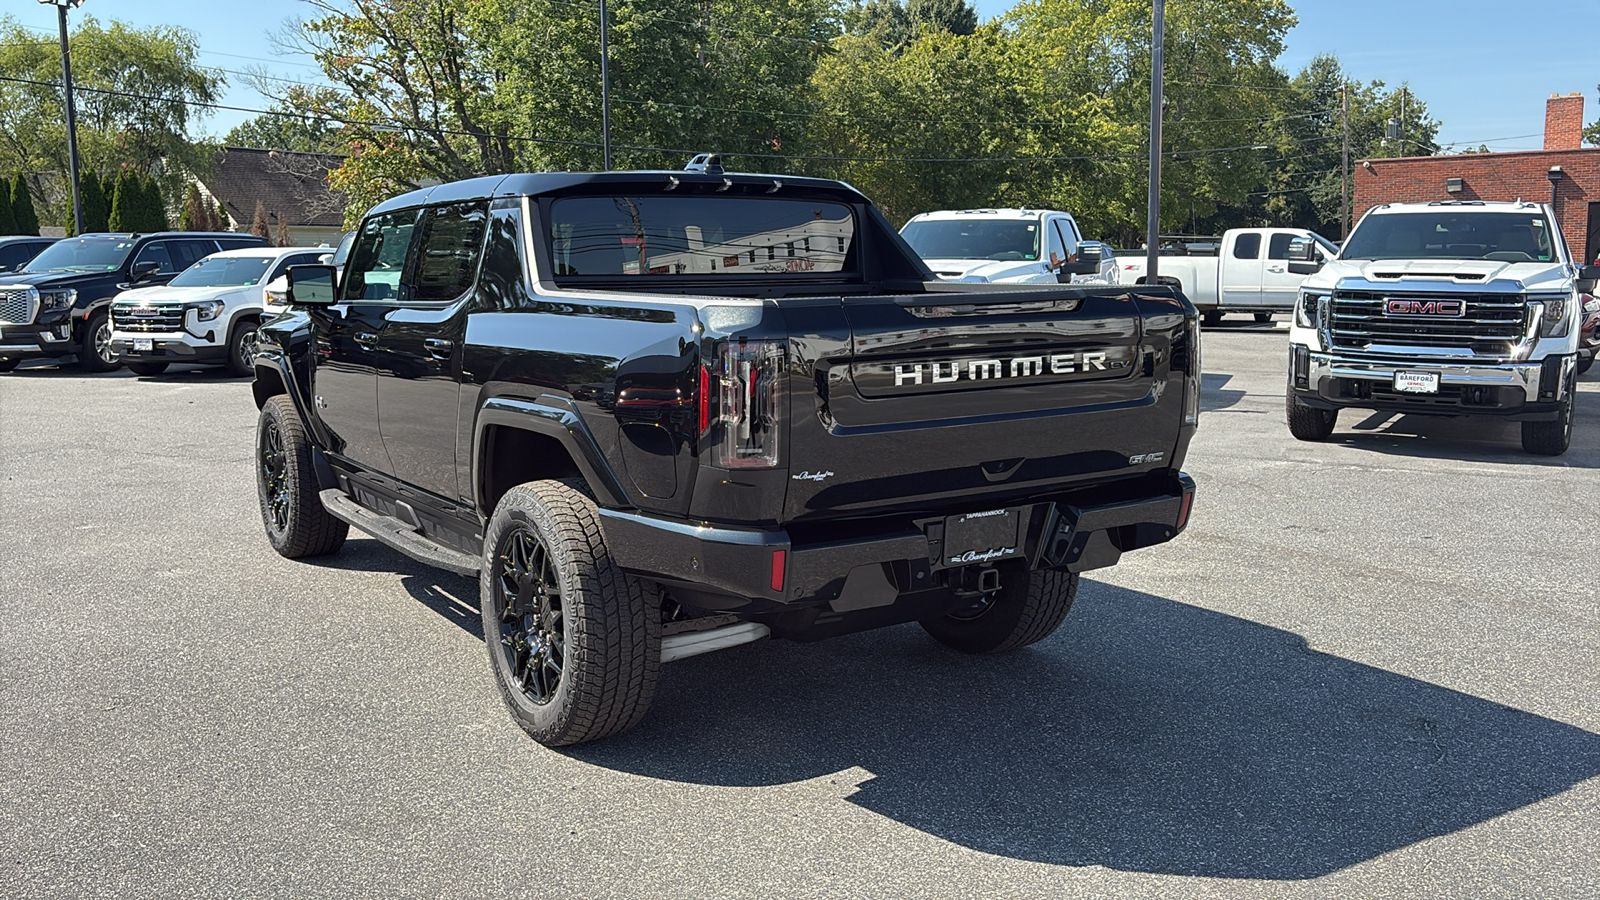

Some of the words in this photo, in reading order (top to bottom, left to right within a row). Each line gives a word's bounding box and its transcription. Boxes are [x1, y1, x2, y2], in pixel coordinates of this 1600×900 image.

[1389, 301, 1460, 314] GMC
[894, 351, 1107, 387] HUMMER
[1109, 360, 1130, 369] EV
[1128, 451, 1165, 465] GMC
[966, 509, 1006, 519] TAPPAHANNOCK
[961, 547, 1006, 562] Bareford
